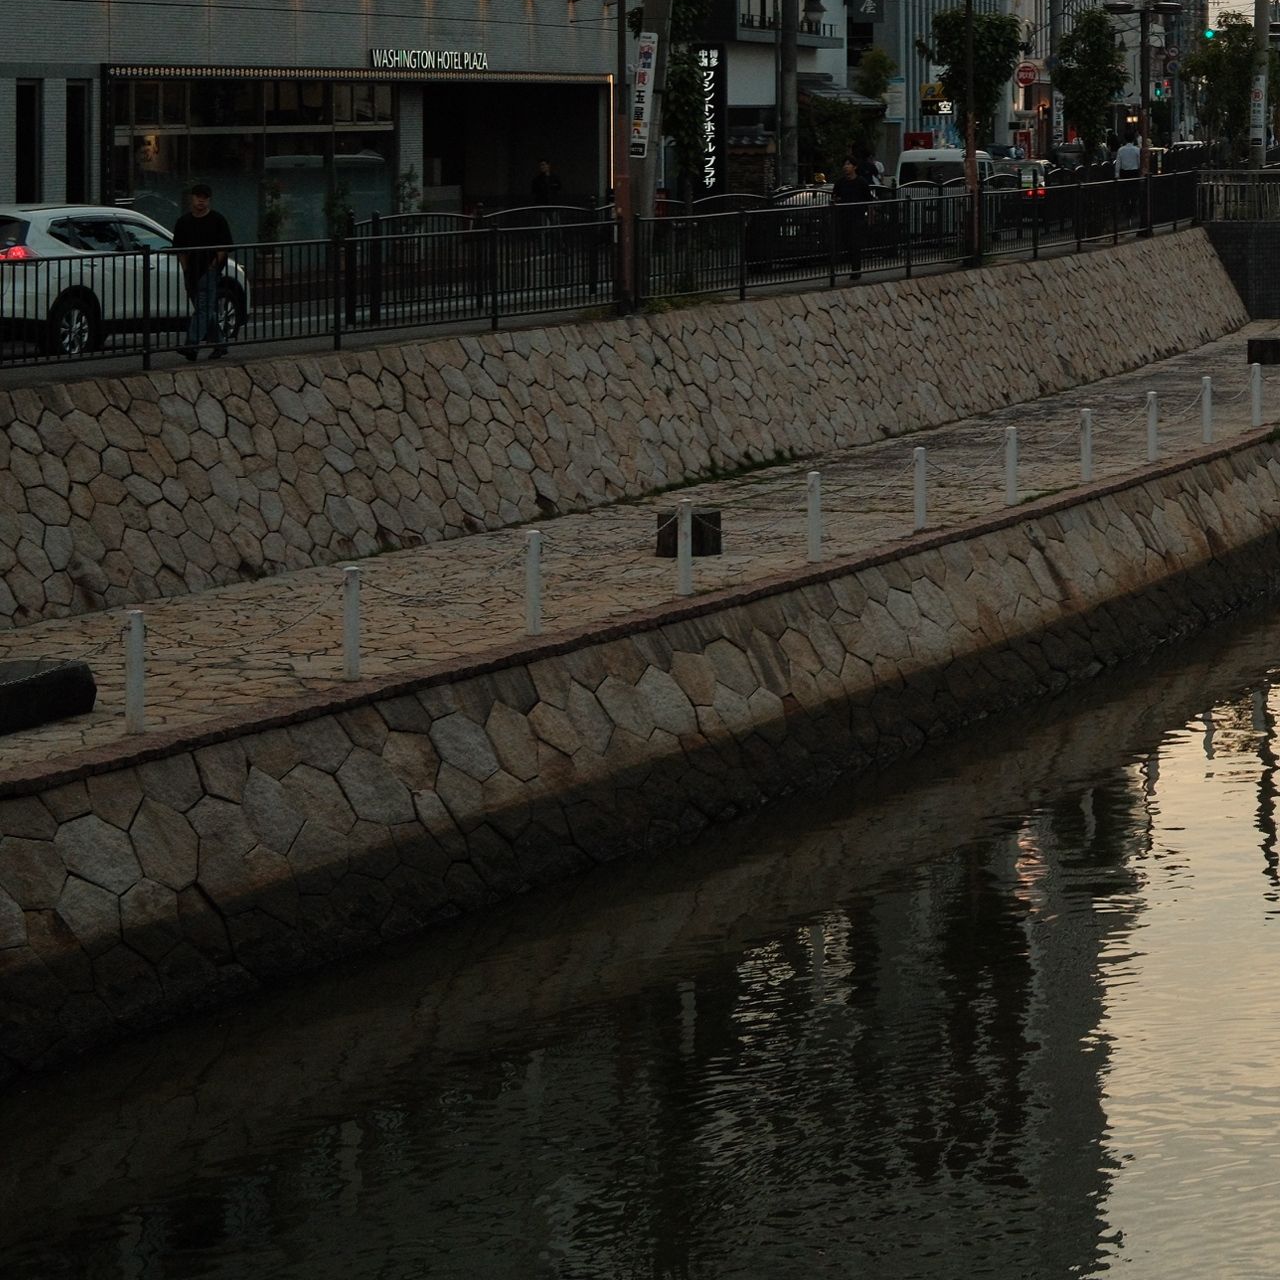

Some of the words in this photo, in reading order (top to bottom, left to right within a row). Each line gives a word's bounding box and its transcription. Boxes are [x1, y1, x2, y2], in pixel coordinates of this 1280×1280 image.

[372, 48, 436, 69] WASHINGTON
[437, 51, 463, 70] HOTEL
[463, 52, 489, 70] PLAZA
[937, 100, 953, 115] 空
[702, 155, 717, 189] プラザ
